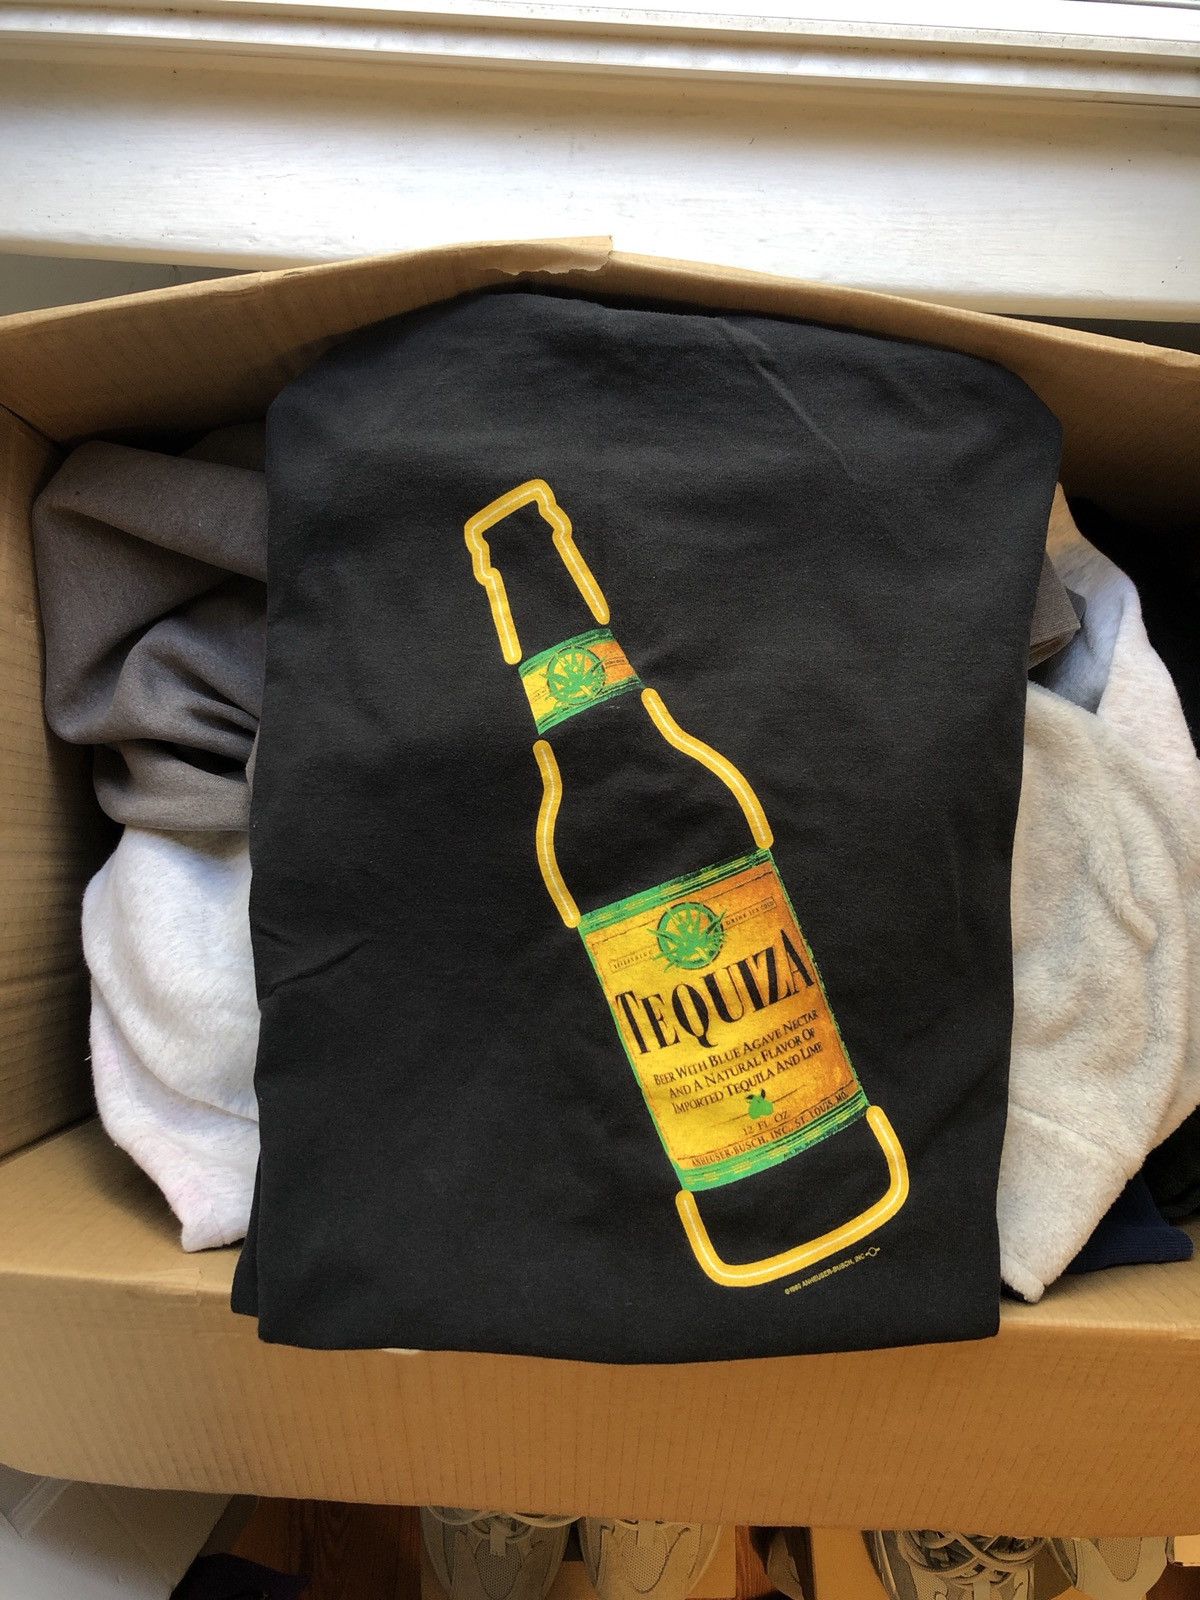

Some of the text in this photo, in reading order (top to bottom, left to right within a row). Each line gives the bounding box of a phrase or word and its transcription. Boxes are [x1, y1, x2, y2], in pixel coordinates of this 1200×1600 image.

[615, 928, 814, 1055] TEQUIZA
[653, 1009, 818, 1086] BEER WITH BLUE AGAVE NECTAR
[669, 1027, 816, 1099] AND A NATURAL FLAVOR OF
[672, 1041, 823, 1114] IMPORTED TEQUILA AND LIME
